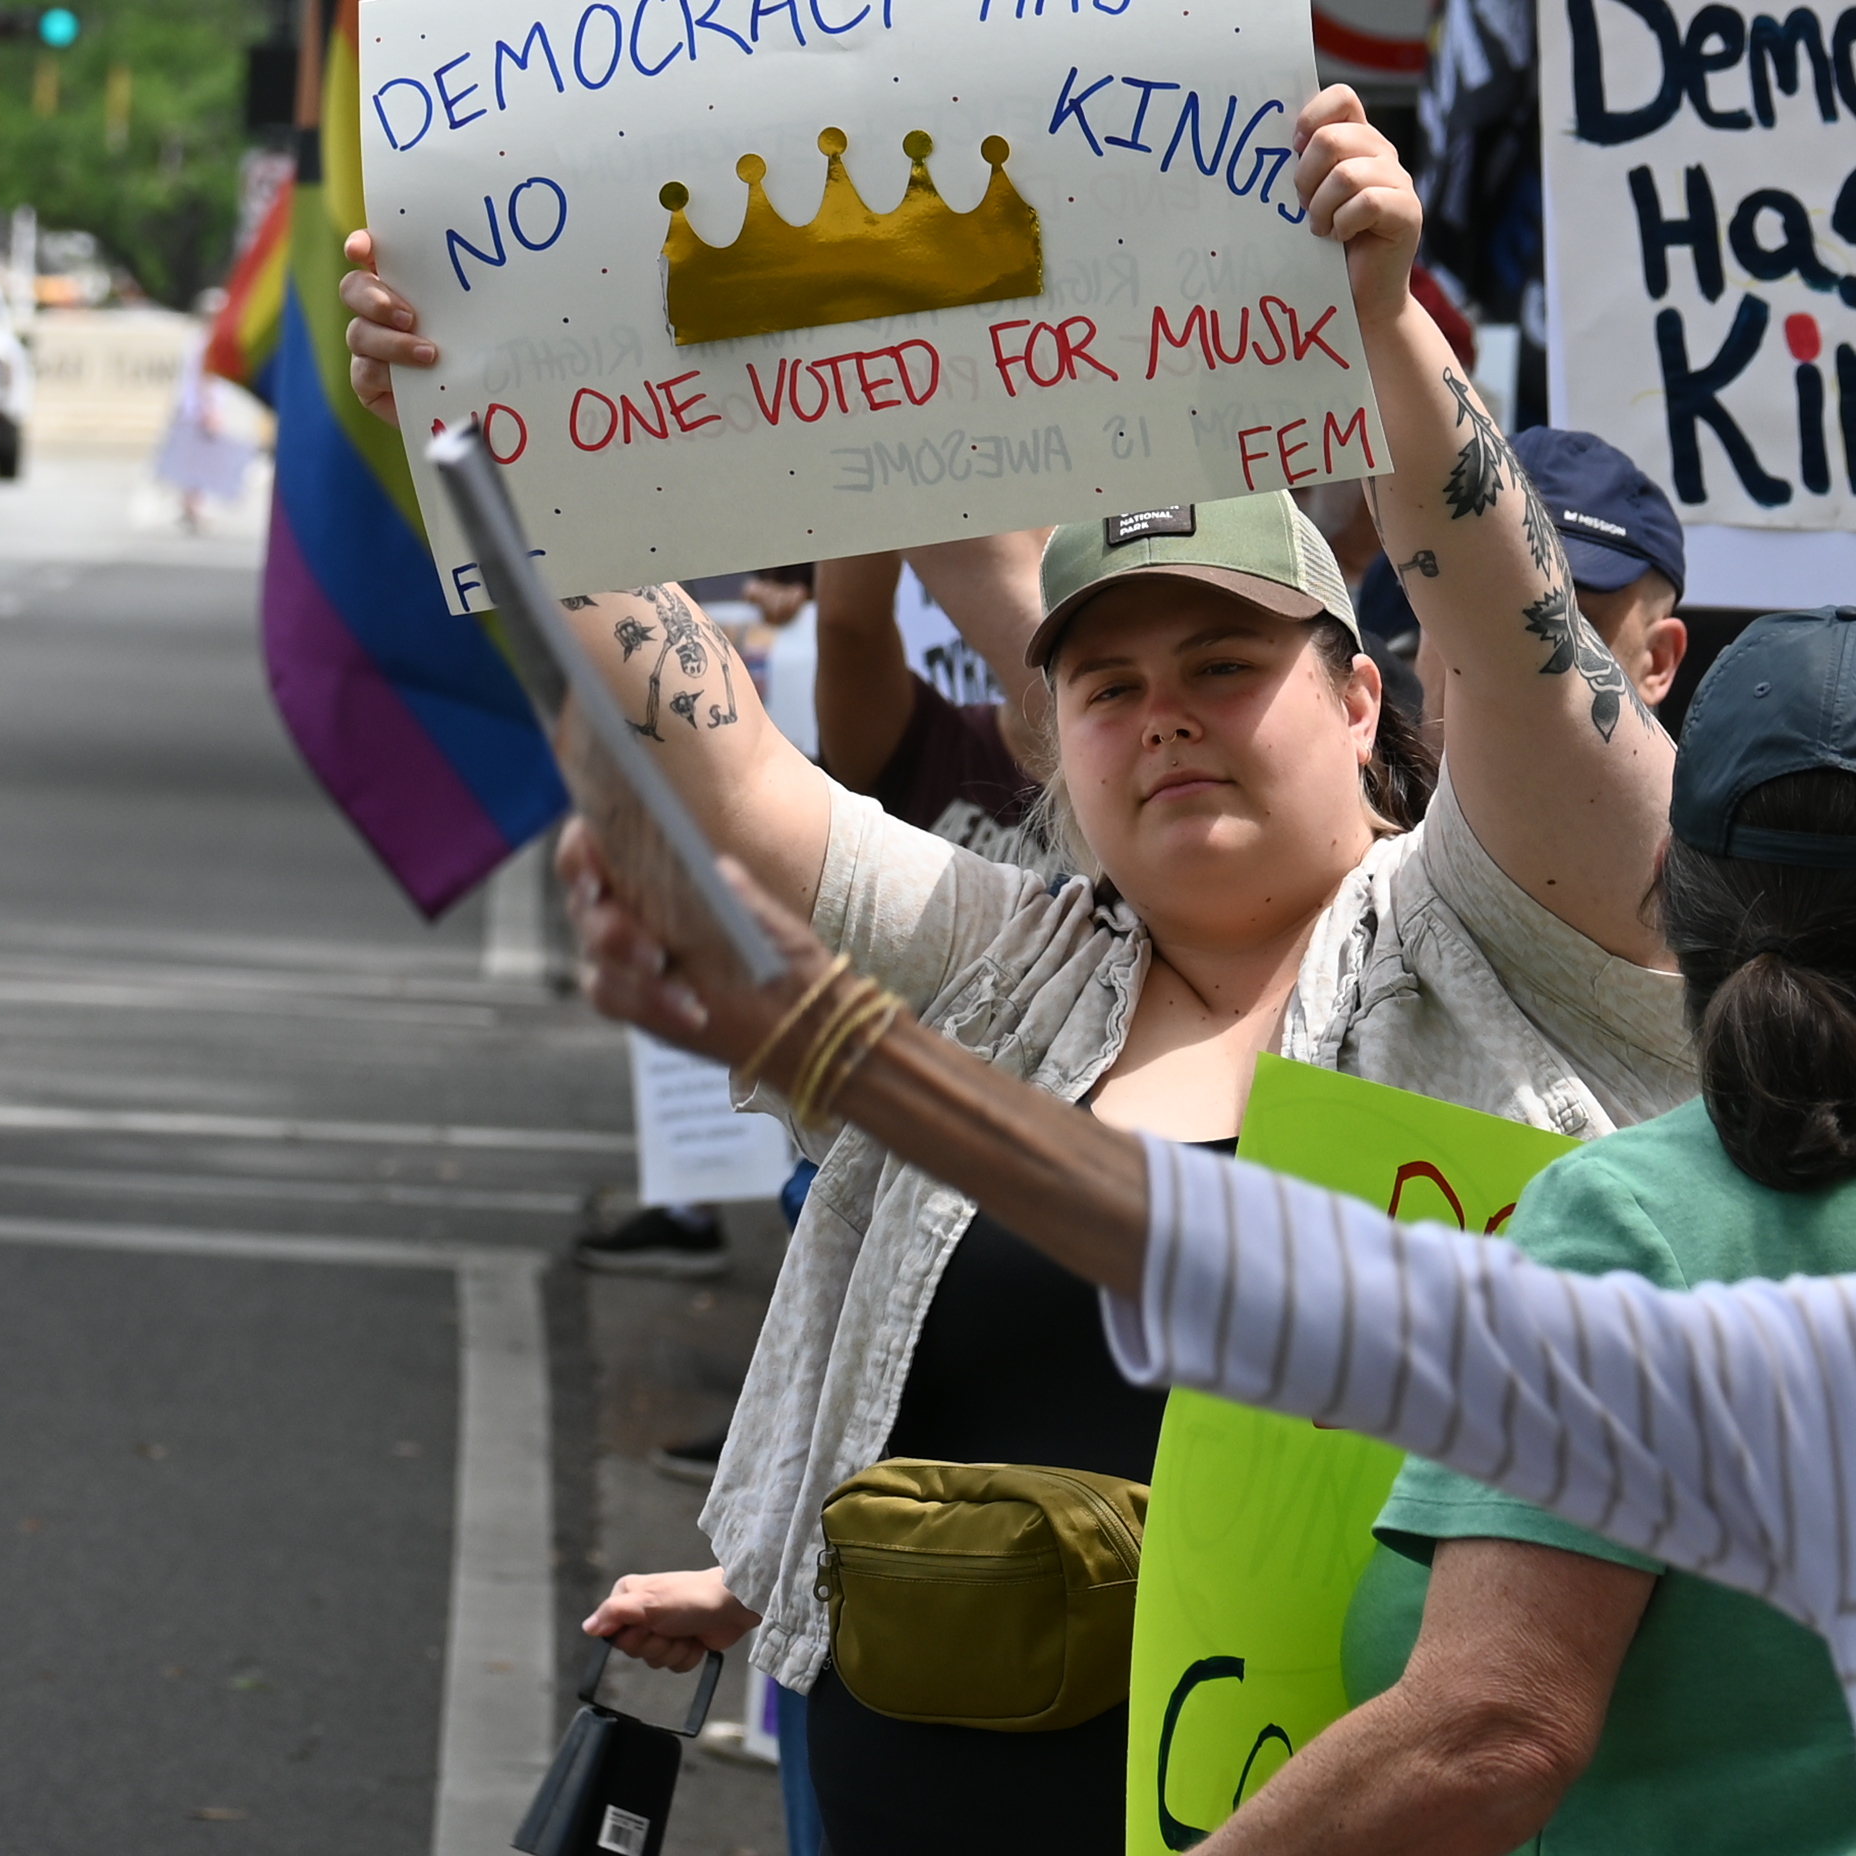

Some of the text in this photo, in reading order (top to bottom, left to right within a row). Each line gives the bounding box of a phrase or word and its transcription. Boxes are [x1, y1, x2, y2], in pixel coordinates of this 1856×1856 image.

[444, 174, 569, 292] NO
[430, 293, 1352, 466] O ONE VOTED FOR MUSK
[1237, 406, 1376, 491] FEM
